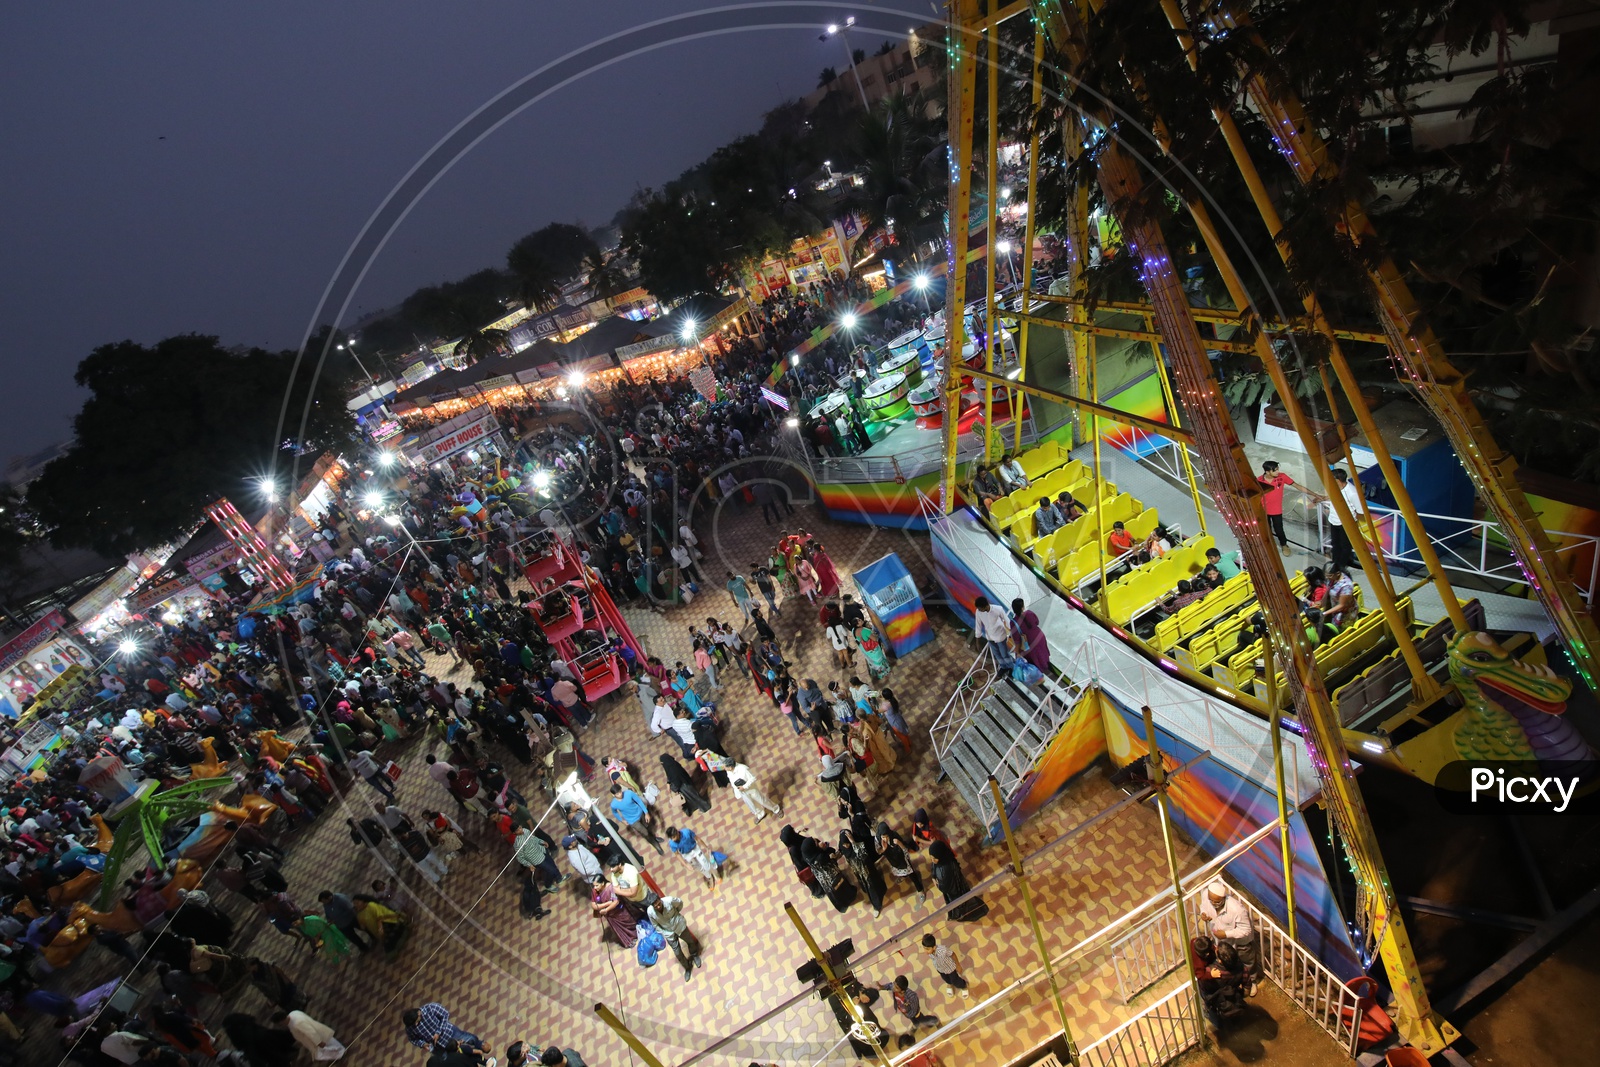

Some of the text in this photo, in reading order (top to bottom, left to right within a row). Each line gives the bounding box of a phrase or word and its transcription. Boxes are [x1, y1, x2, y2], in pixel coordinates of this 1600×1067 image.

[527, 320, 556, 337] DCOR
[435, 424, 483, 454] PUFF HOUSE
[141, 583, 179, 602] KERALA
[0, 627, 52, 672] HING HOUSE
